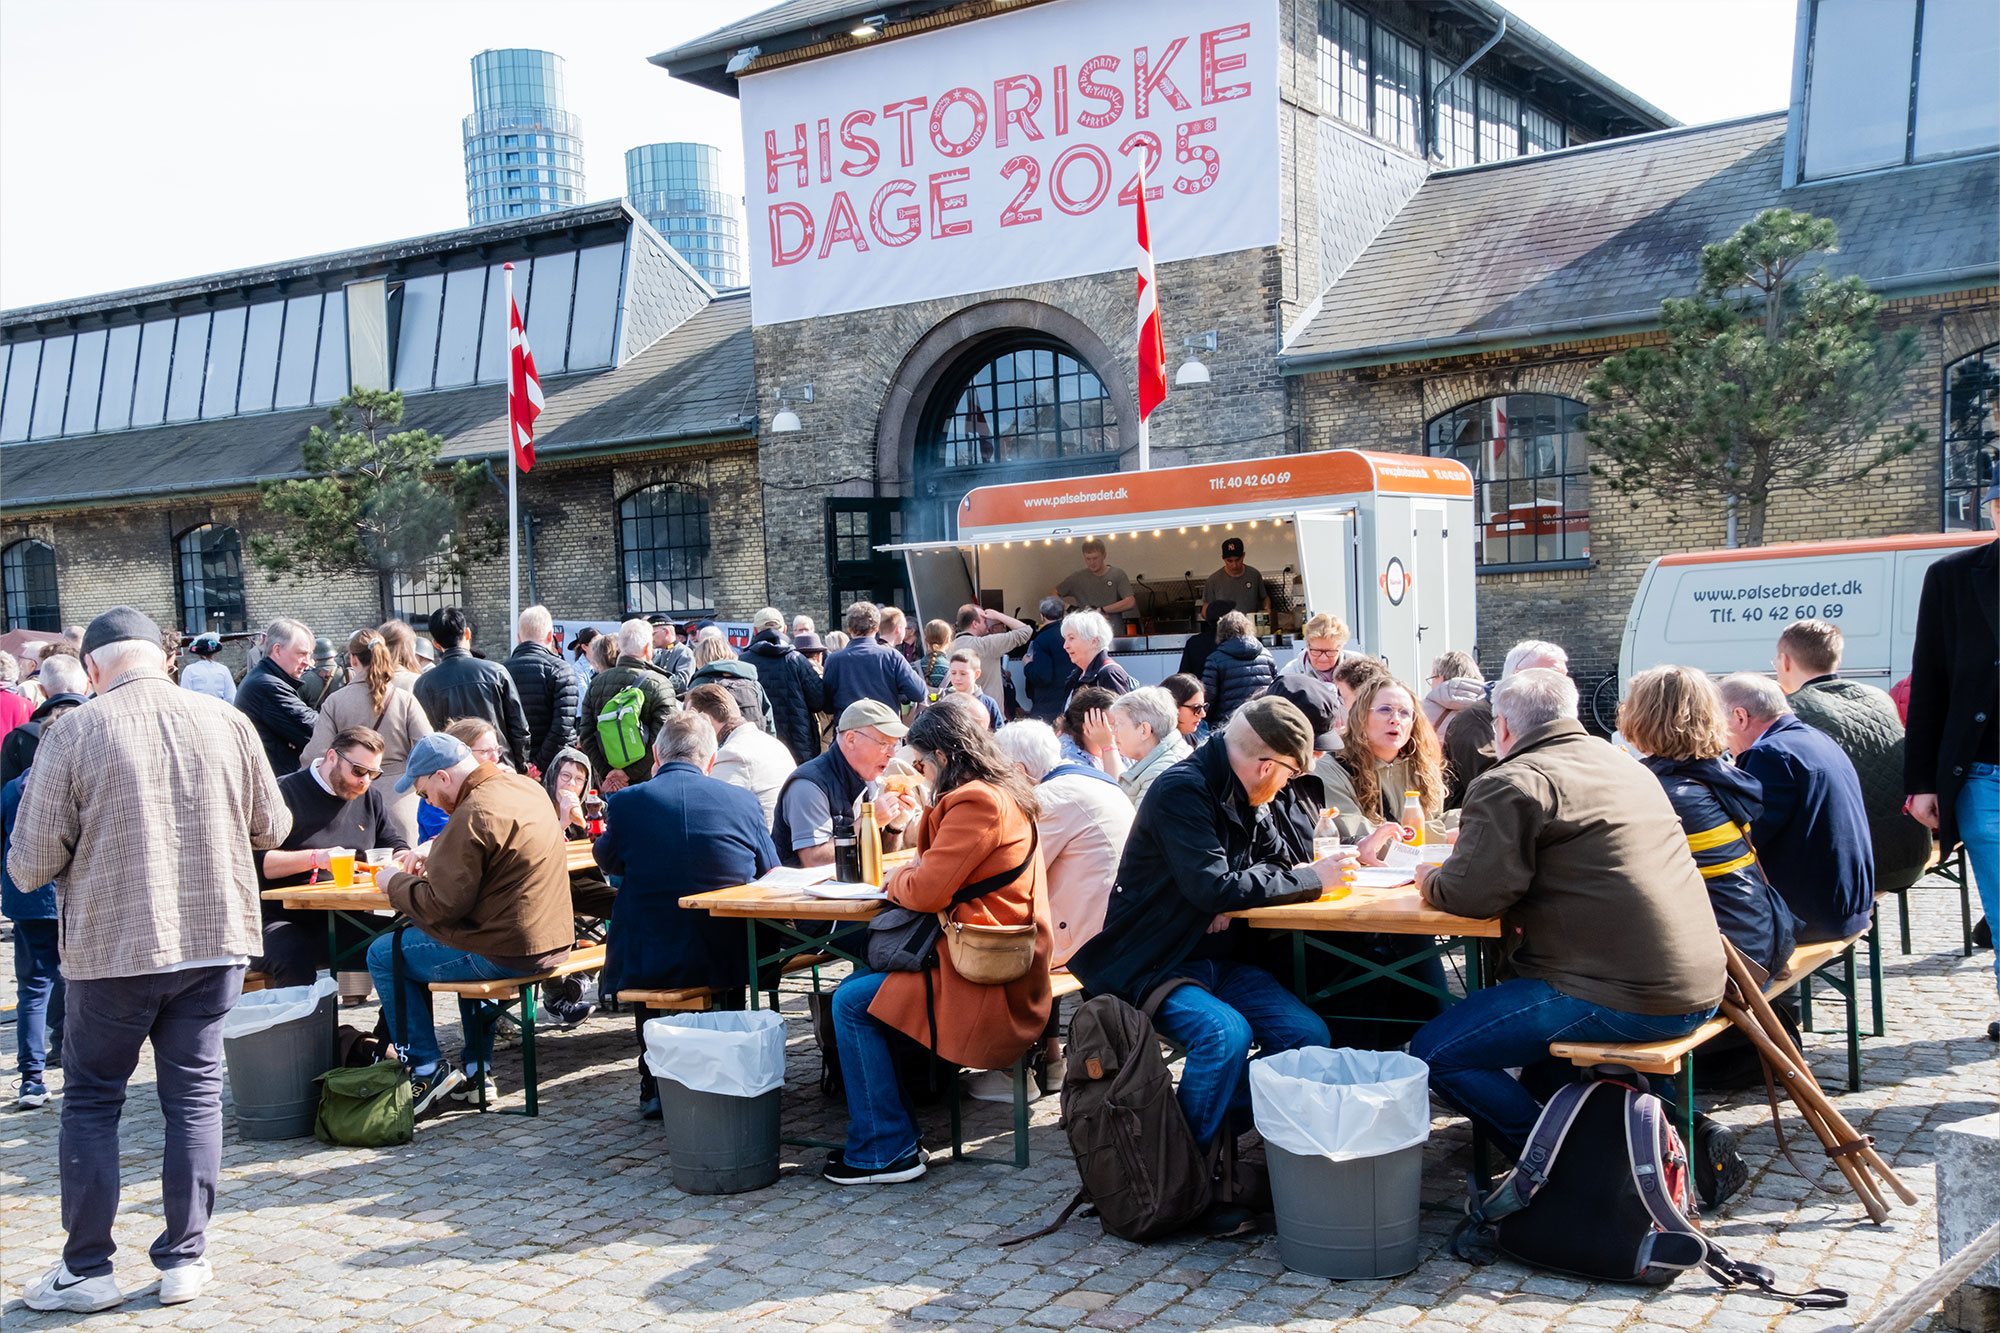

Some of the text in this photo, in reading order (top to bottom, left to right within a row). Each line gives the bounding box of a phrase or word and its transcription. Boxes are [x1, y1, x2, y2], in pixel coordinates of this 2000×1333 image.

[765, 23, 1251, 194] HISTORISKE
[768, 117, 1220, 267] DAGE 2025
[1209, 471, 1291, 490] Tlf. 40 42 60 69
[1024, 487, 1128, 508] www.pølsebrødet.dk
[1693, 580, 1862, 601] www.pølsebrødet.dk
[1710, 603, 1843, 623] Tlf. 40 42 60 69
